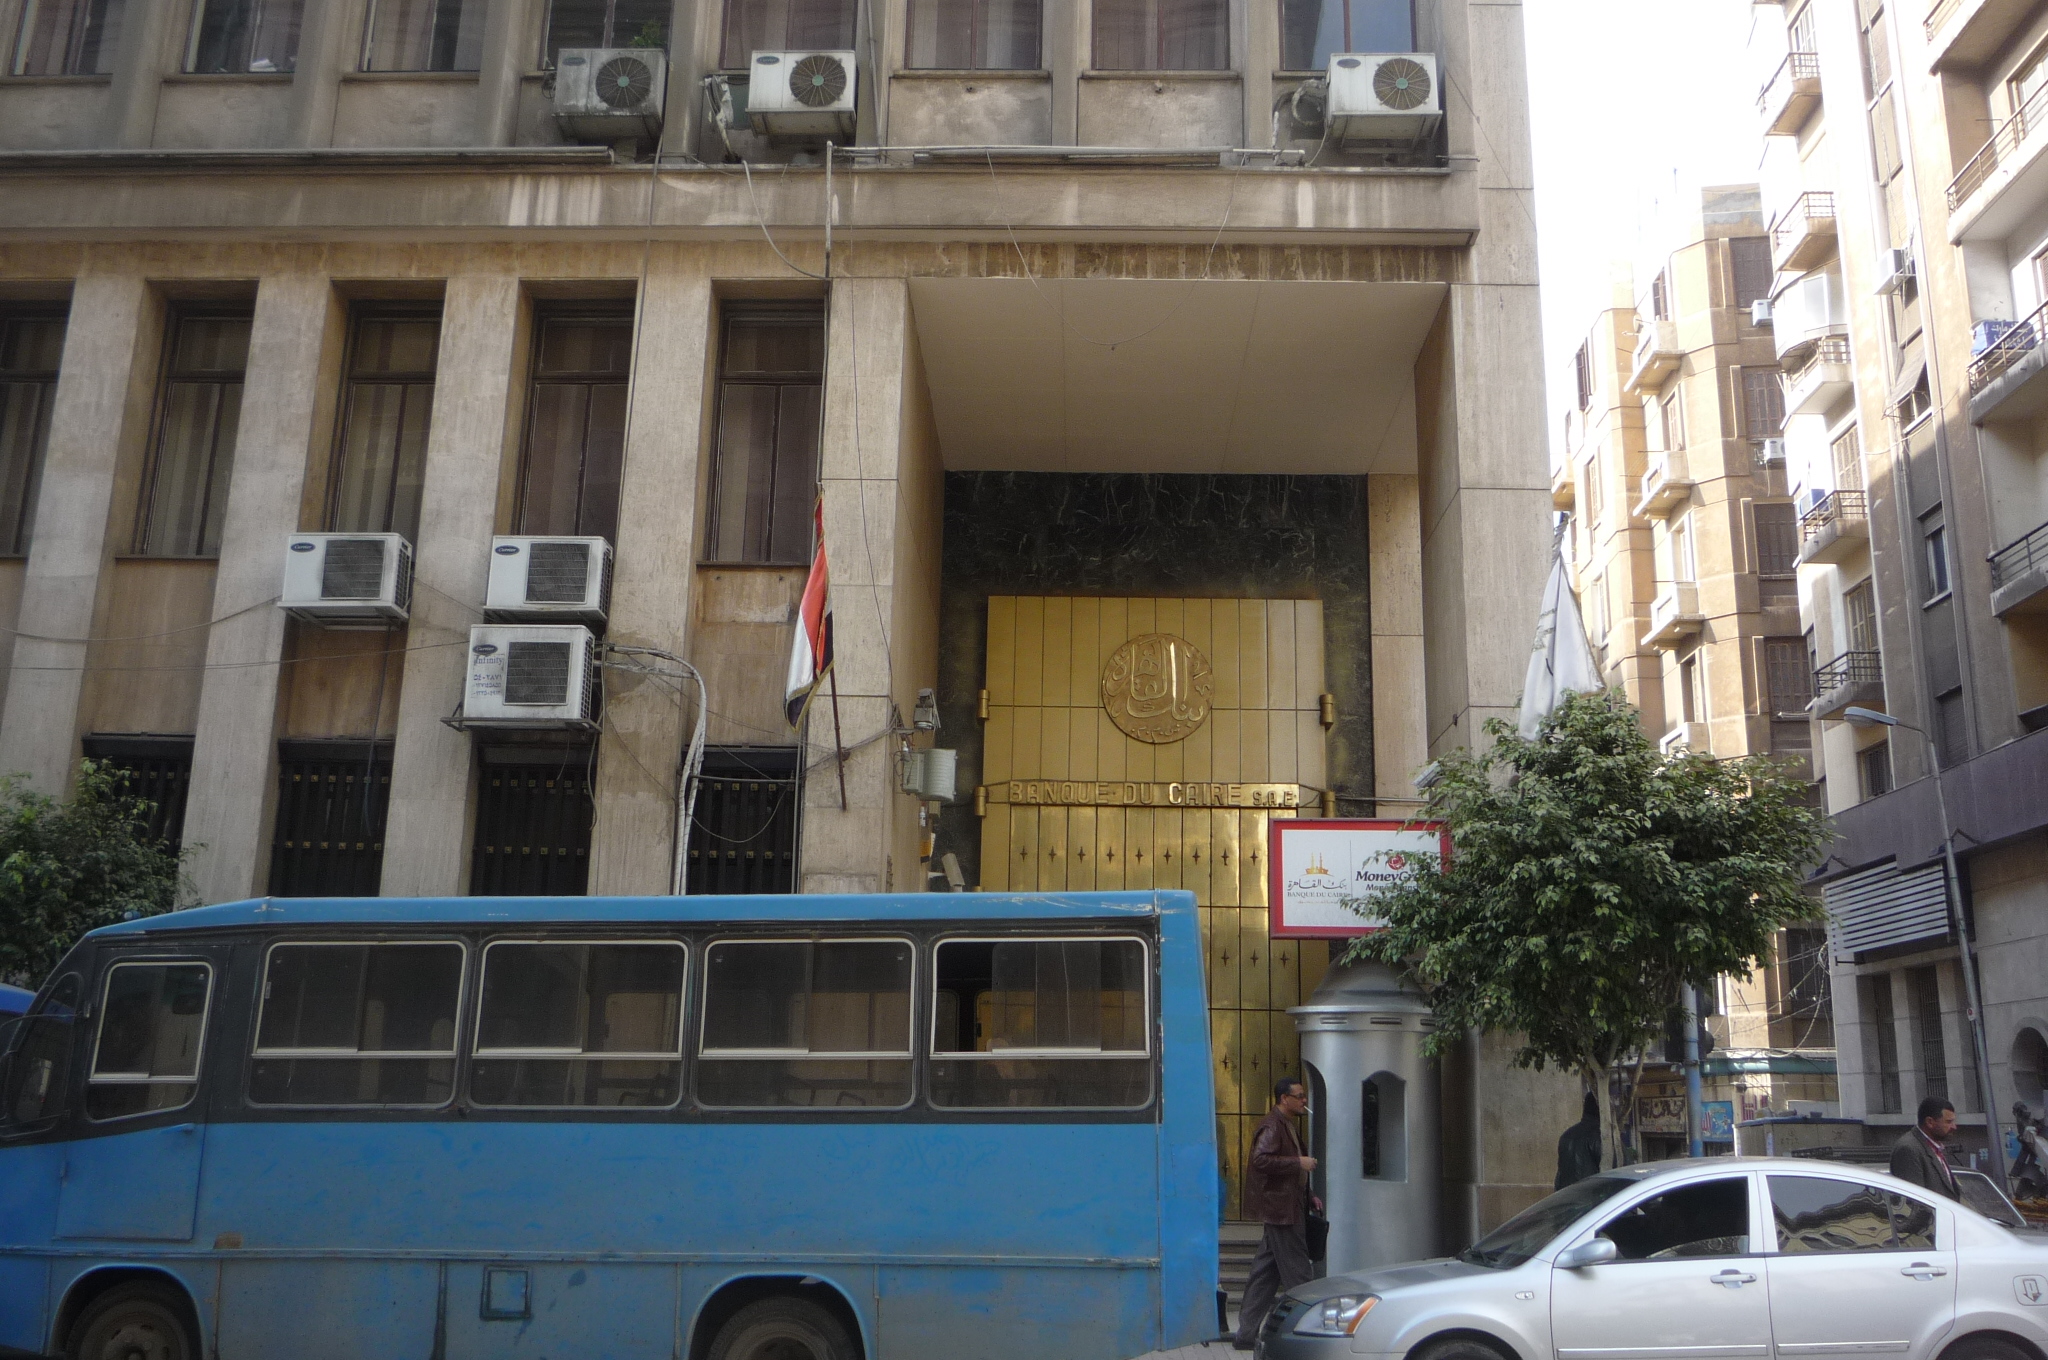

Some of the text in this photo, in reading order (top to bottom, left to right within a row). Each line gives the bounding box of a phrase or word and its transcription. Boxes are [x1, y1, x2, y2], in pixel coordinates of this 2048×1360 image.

[1009, 782, 1110, 805] BANQUE
[1124, 783, 1154, 805] DU
[1168, 783, 1242, 806] CAIRE
[1355, 871, 1420, 882] MoneyGr
[1287, 878, 1347, 891] بنك القاهرة
